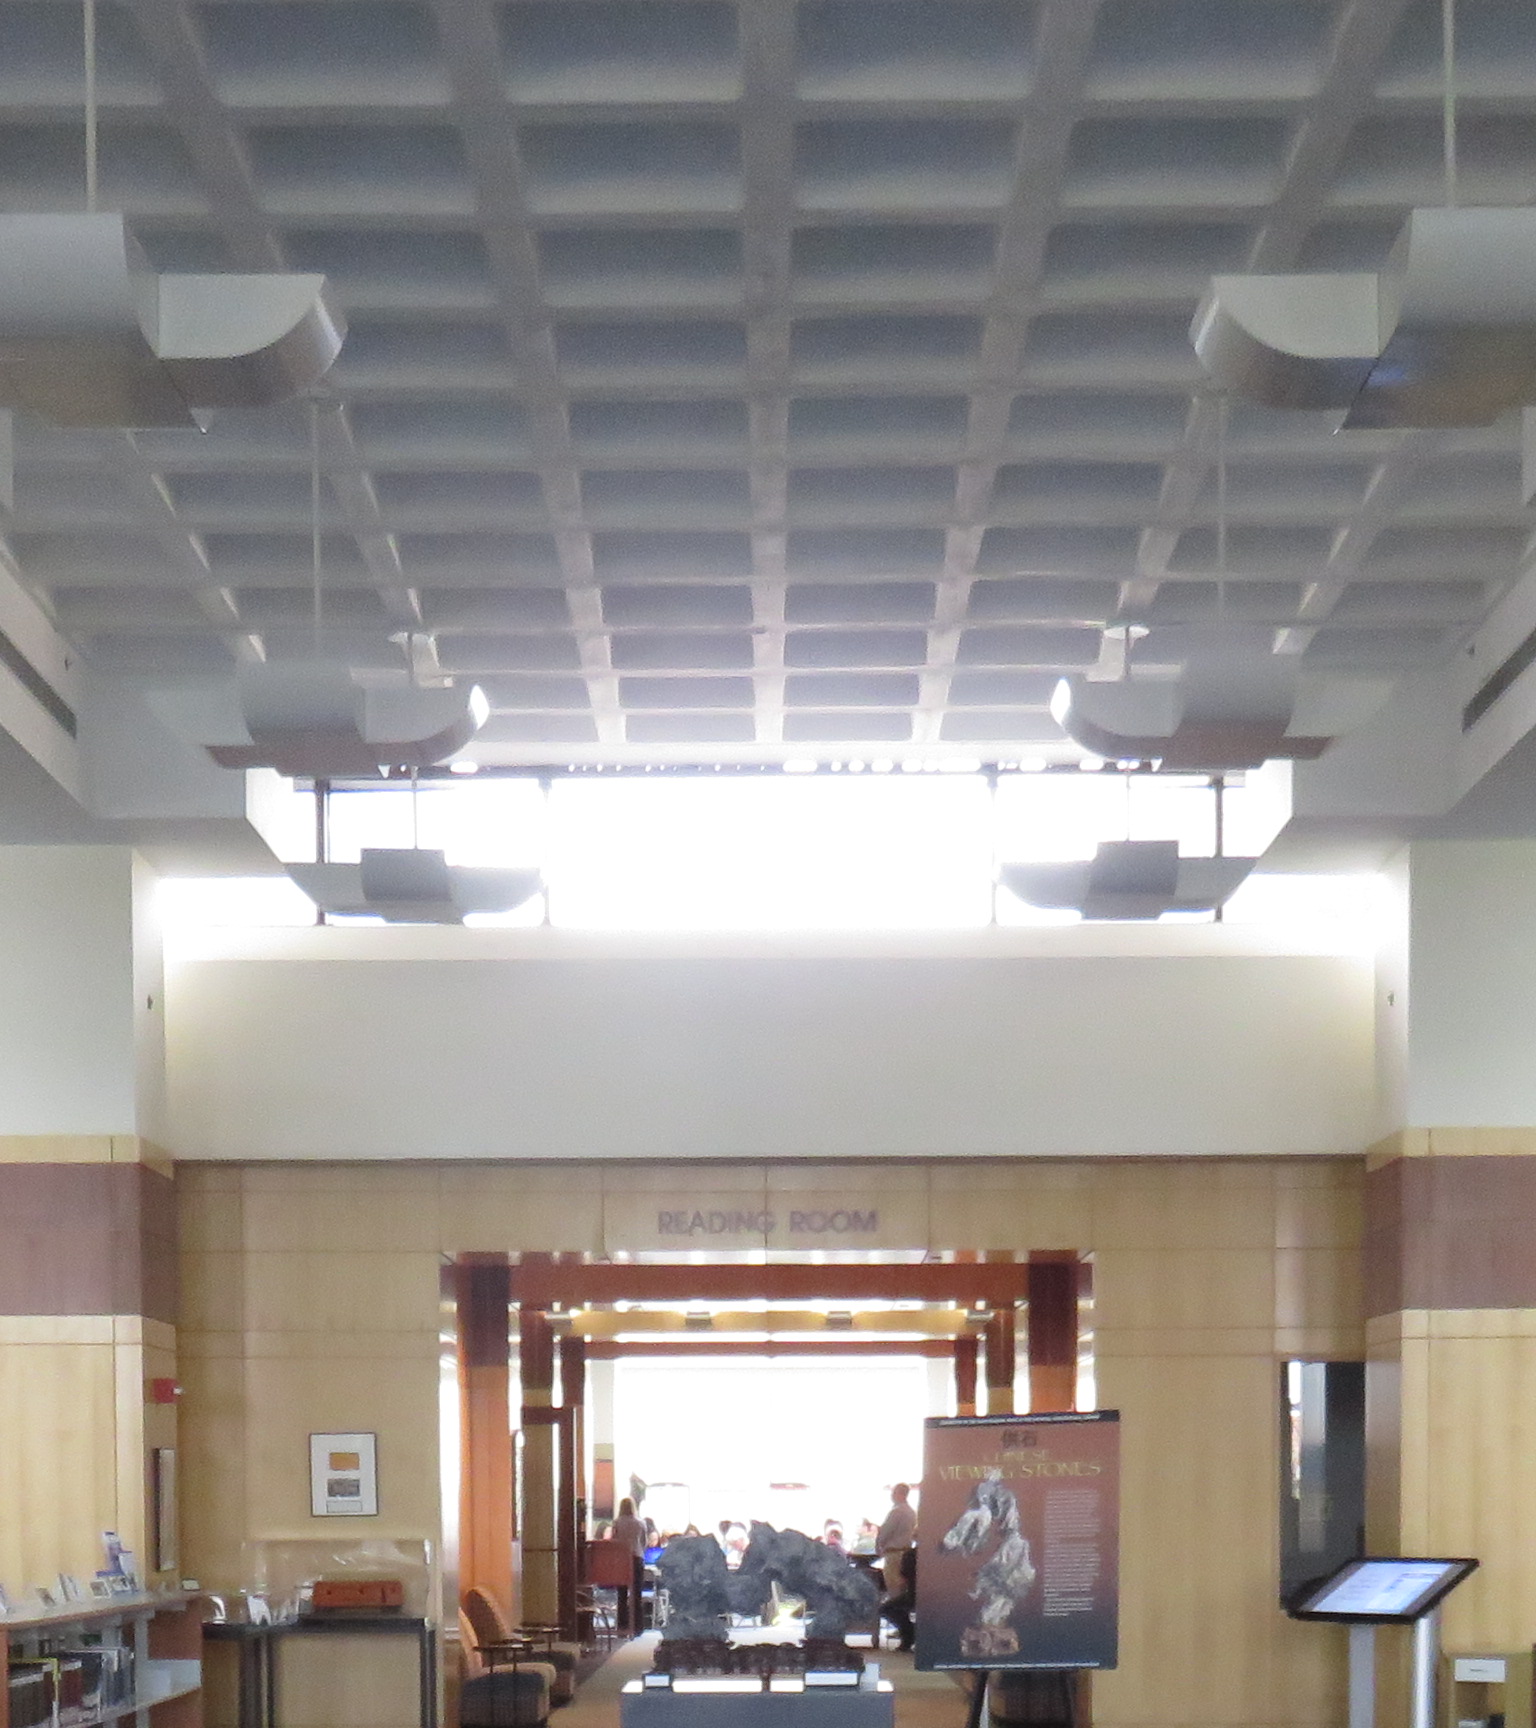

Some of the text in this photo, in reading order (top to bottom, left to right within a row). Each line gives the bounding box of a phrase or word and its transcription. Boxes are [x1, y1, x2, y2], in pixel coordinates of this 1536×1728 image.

[657, 1209, 878, 1234] READING ROOM
[1020, 1460, 1102, 1478] STONES
